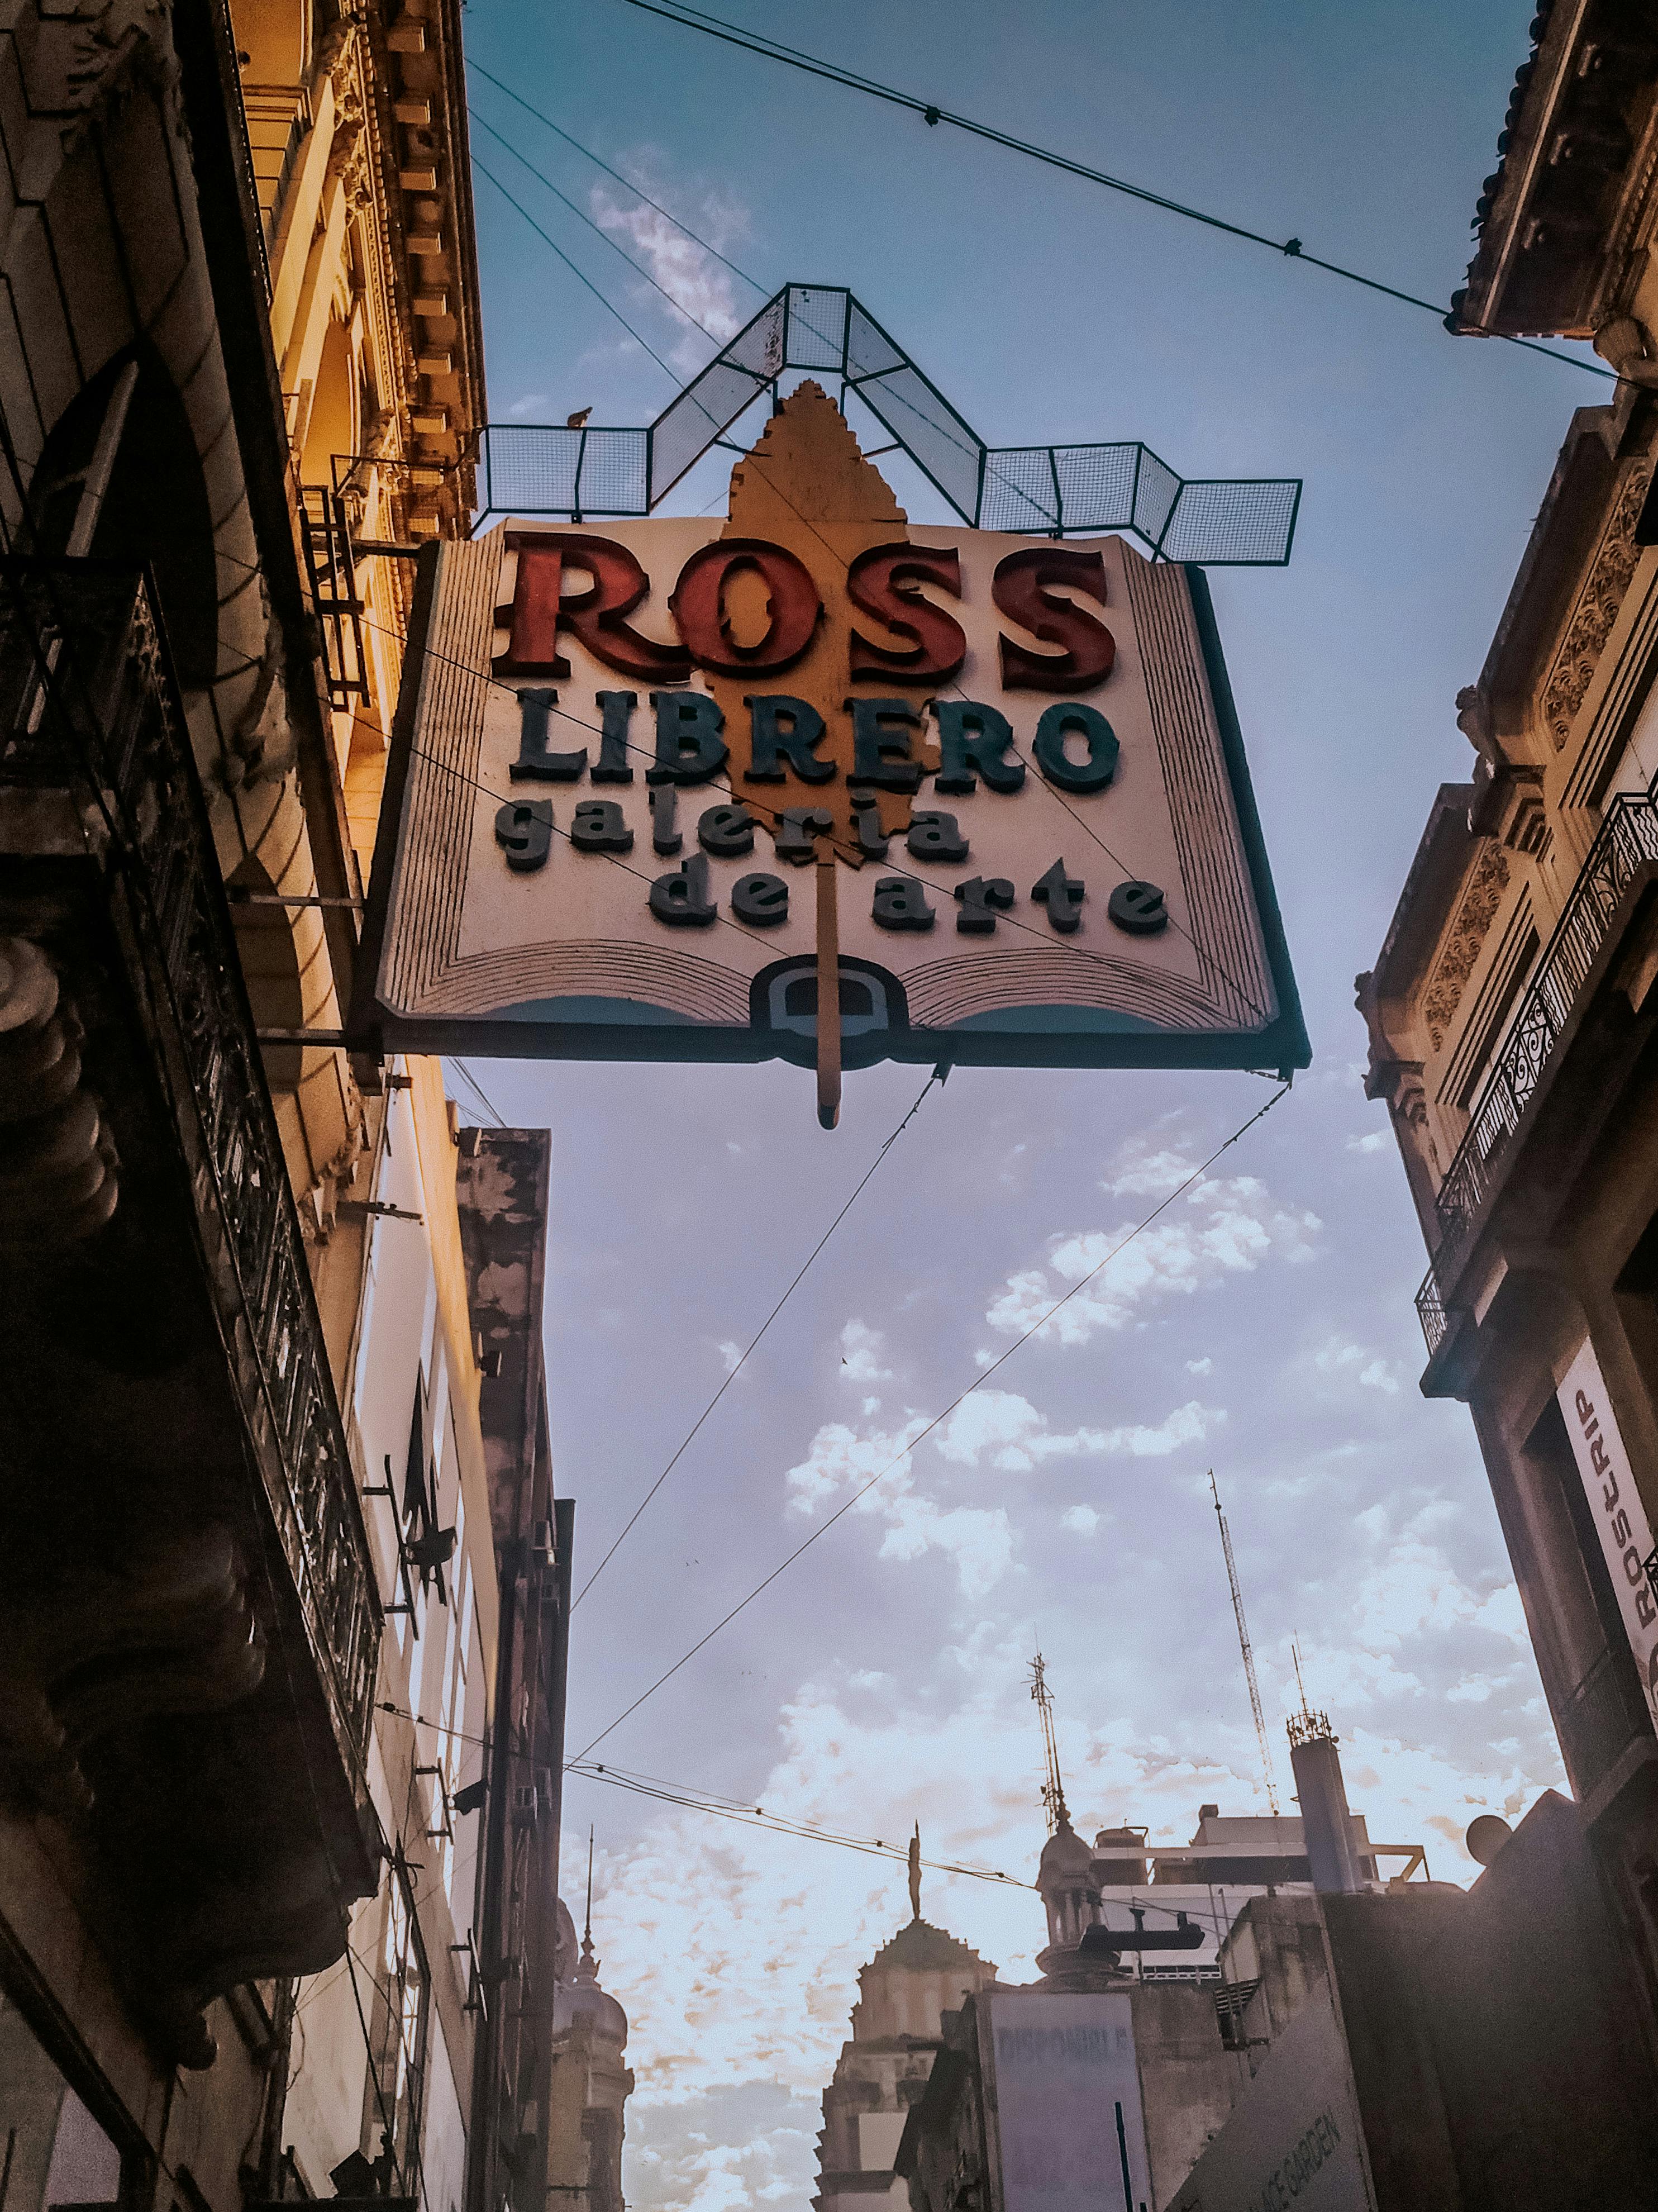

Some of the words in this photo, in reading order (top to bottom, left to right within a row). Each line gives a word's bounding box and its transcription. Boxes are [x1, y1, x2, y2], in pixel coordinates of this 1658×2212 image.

[492, 530, 1116, 689] ROSS
[509, 687, 1119, 794] LIBRERO
[648, 851, 790, 927] de
[871, 857, 1169, 935] arte
